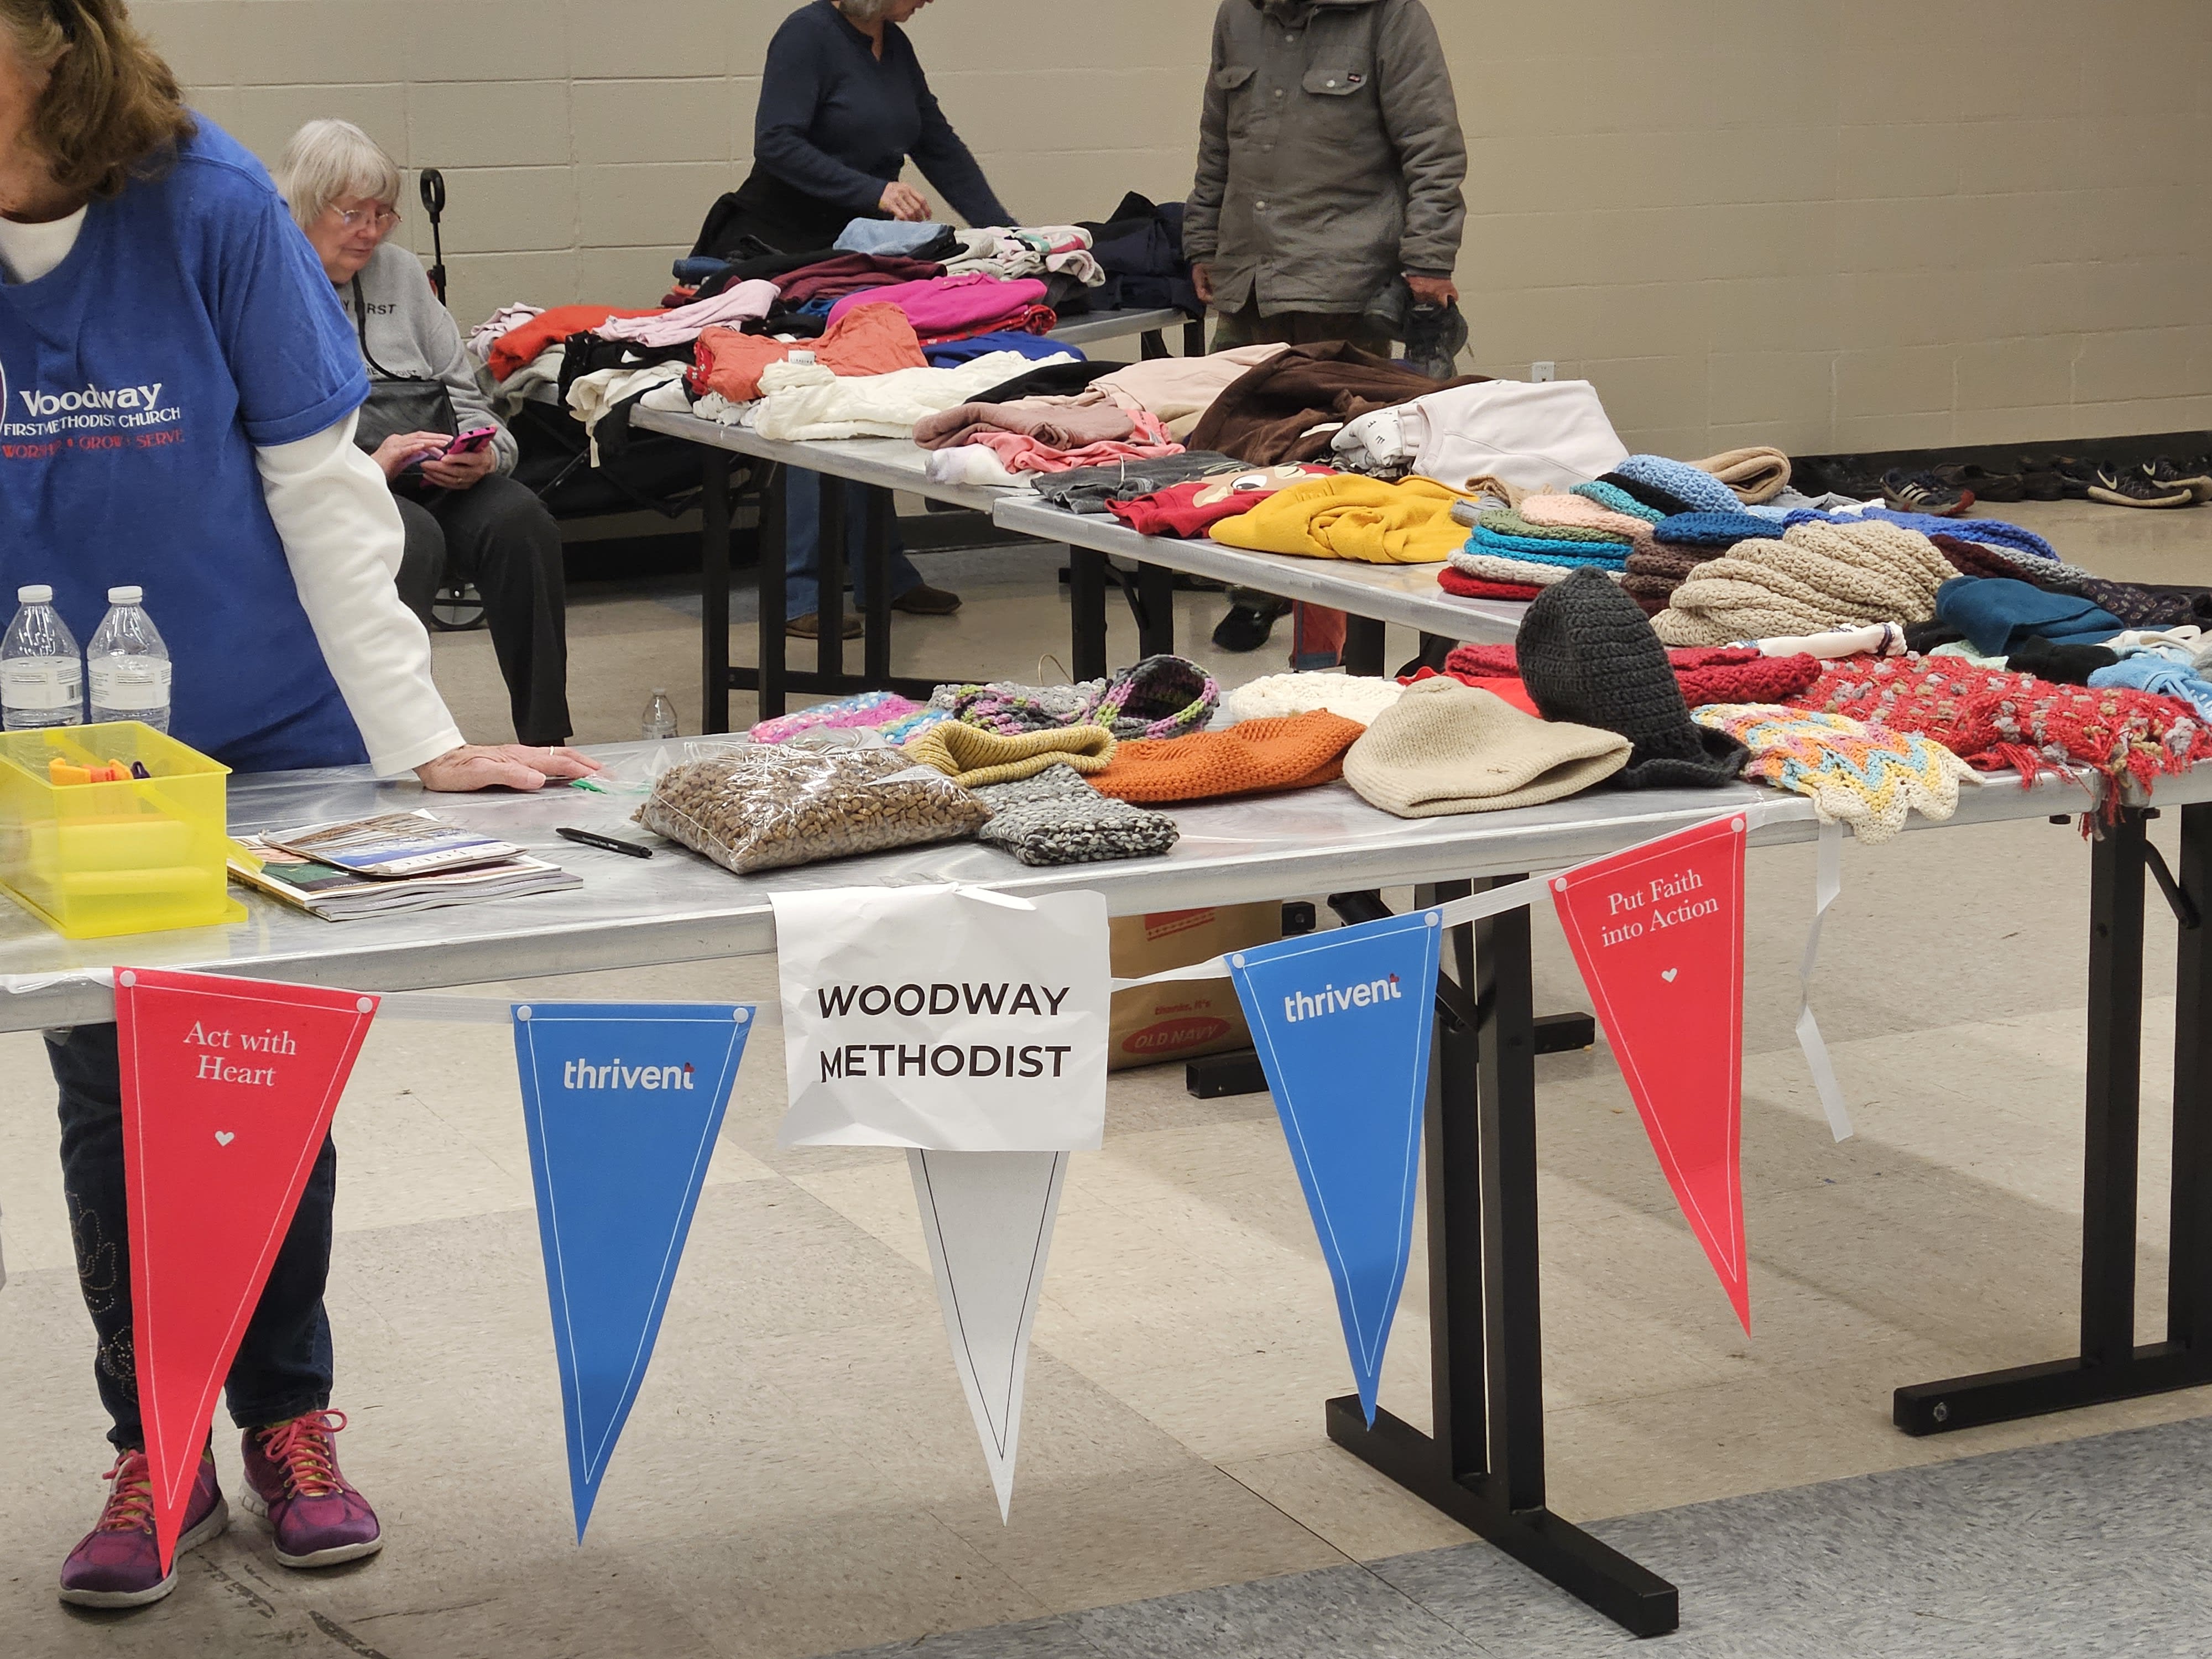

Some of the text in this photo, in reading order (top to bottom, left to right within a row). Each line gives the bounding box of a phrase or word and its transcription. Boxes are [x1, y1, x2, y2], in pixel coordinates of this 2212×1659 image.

[367, 302, 397, 315] RST
[3, 422, 44, 436] FIRST
[118, 406, 181, 428] CHURCH
[136, 429, 185, 449] SERVE
[1607, 869, 1704, 916] Put Faith
[1601, 896, 1720, 947] into Action
[817, 983, 1071, 1019] WOODWAY
[1284, 973, 1401, 1023] thrivent
[183, 1020, 296, 1056] Act with
[1134, 1024, 1219, 1048] OLD NAVY
[195, 1054, 276, 1087] Heart
[563, 1058, 695, 1090] thrivent
[820, 1044, 1072, 1083] METHODIST
